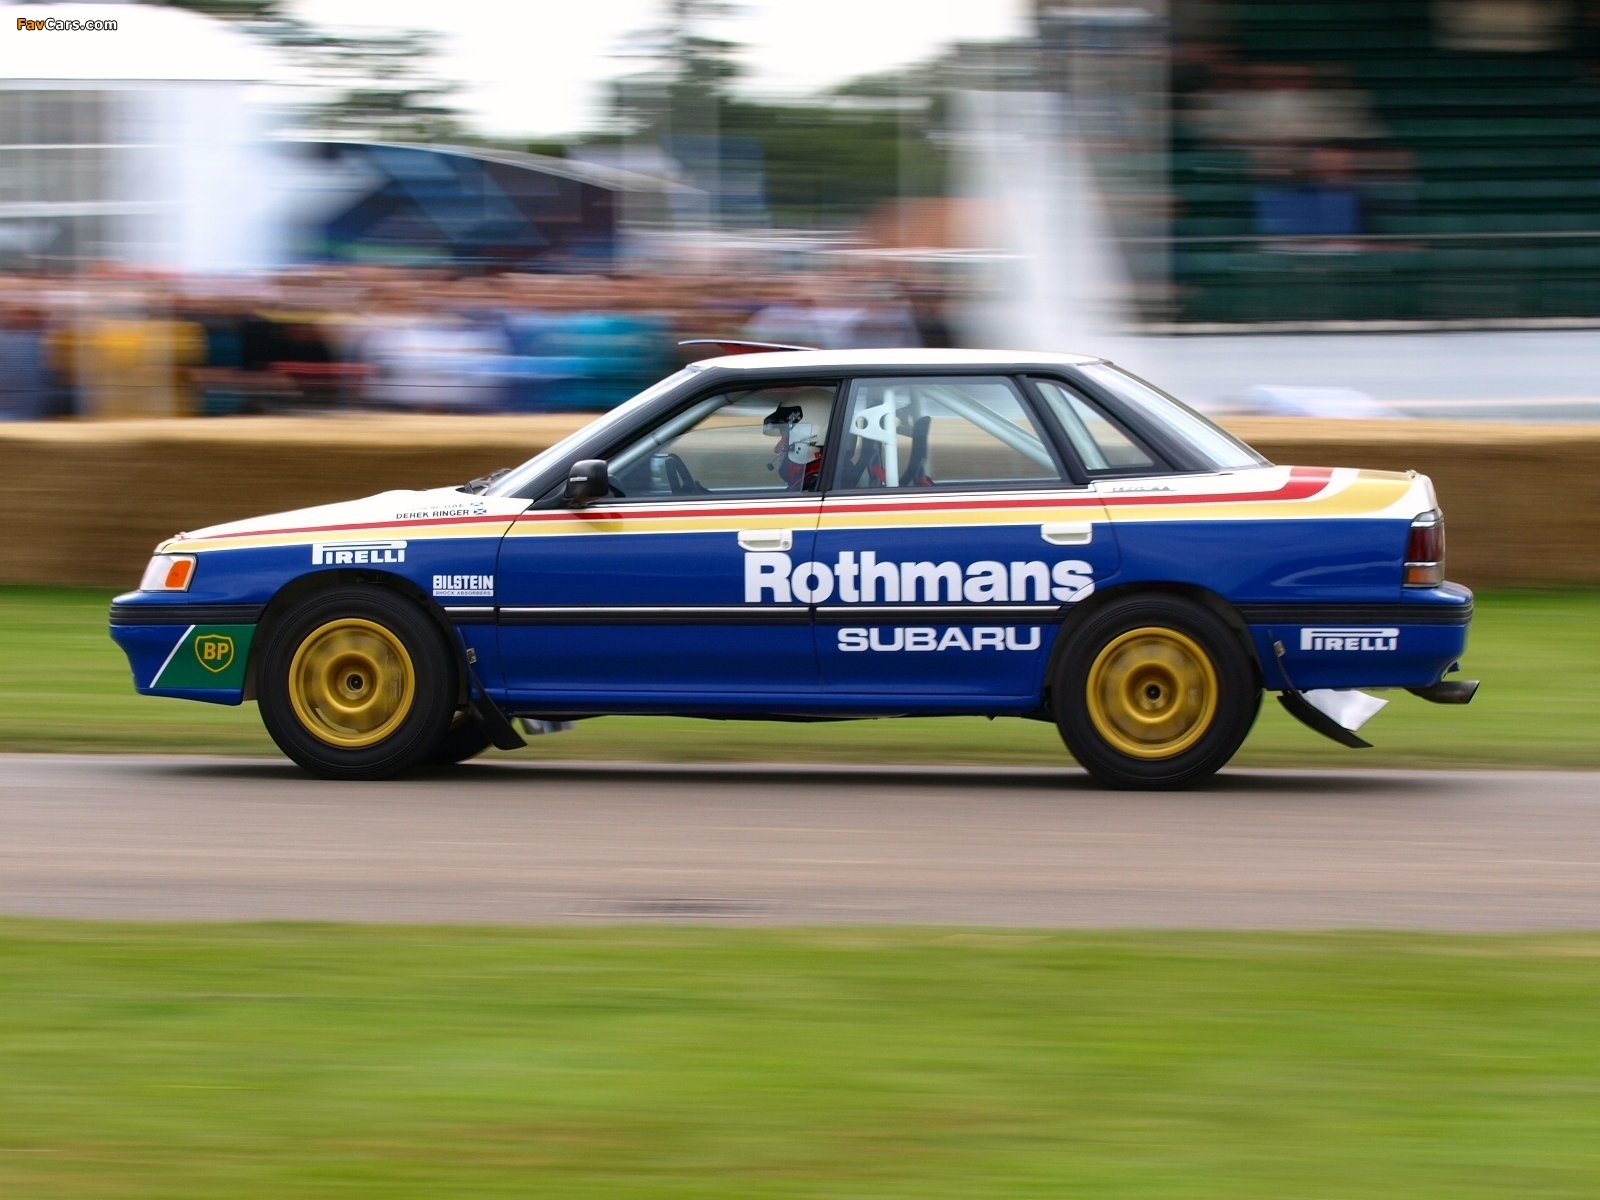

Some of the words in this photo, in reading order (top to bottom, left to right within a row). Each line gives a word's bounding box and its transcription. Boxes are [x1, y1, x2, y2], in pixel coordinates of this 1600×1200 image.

[396, 510, 429, 519] DEREK
[432, 509, 470, 518] RINGER
[312, 540, 408, 565] PIRELLI
[433, 575, 494, 589] BILSTEIN
[744, 551, 1095, 604] Rothmans
[837, 627, 1041, 651] SUBARU
[1300, 628, 1400, 651] PIRELLI
[204, 642, 229, 661] BP
